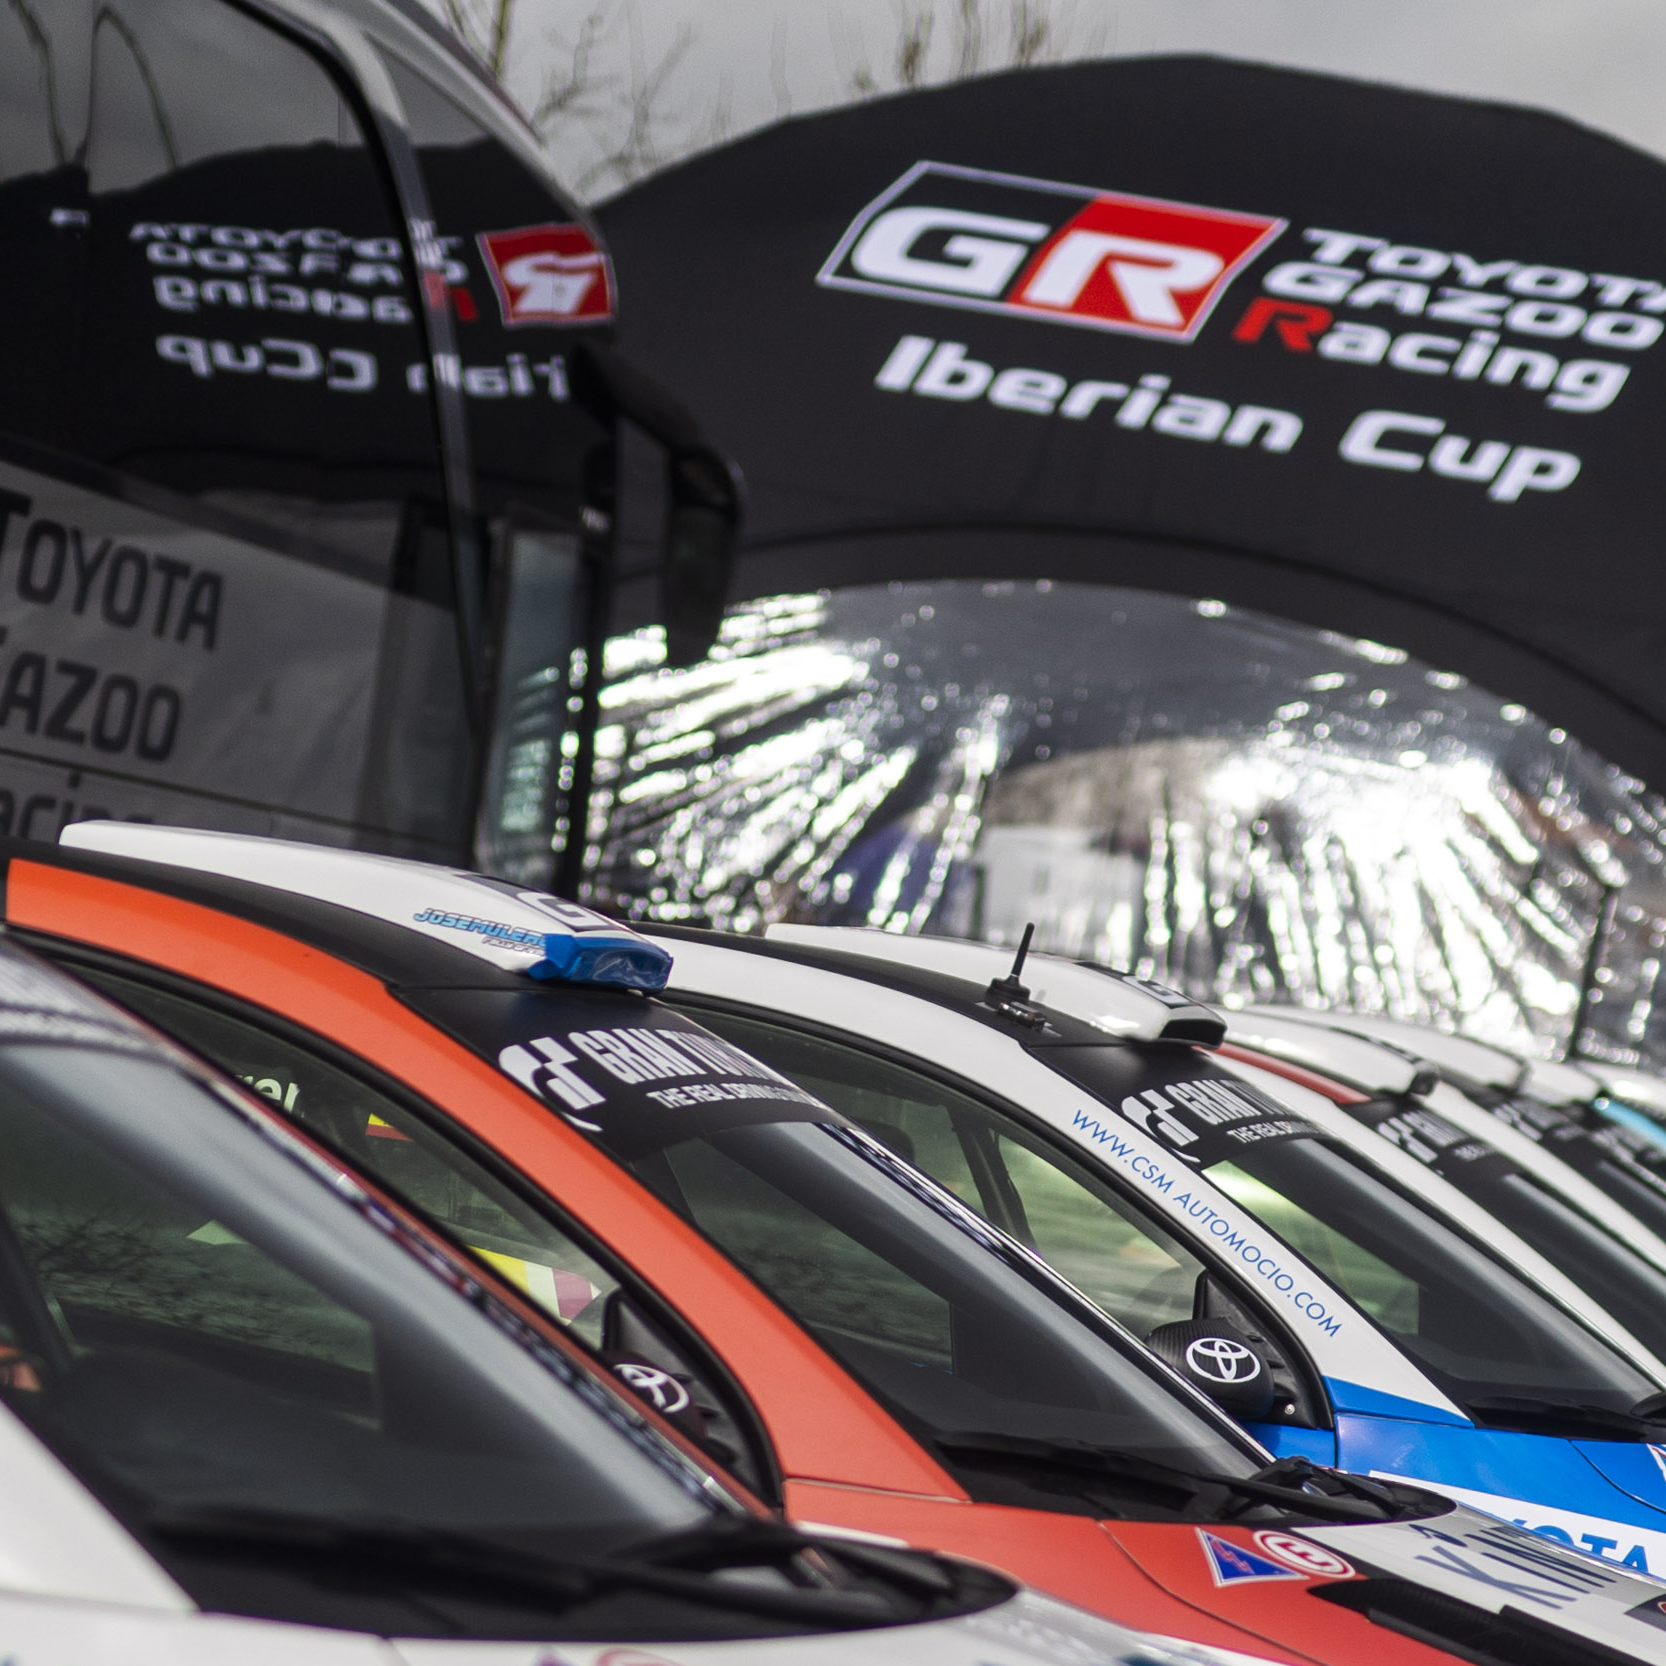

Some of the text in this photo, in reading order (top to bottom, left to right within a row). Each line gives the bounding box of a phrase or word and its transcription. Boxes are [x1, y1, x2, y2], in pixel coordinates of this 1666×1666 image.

[850, 206, 1224, 328] GR
[1265, 263, 1662, 350] GAZOO
[1234, 299, 1630, 412] Racing
[876, 336, 1581, 502] Iberian Cup
[568, 1028, 708, 1085] GRAN
[646, 1087, 697, 1109] THE
[1164, 1079, 1262, 1126] GRAN
[1072, 1109, 1344, 1338] WWW.CSM AUTOMOCIO.COM
